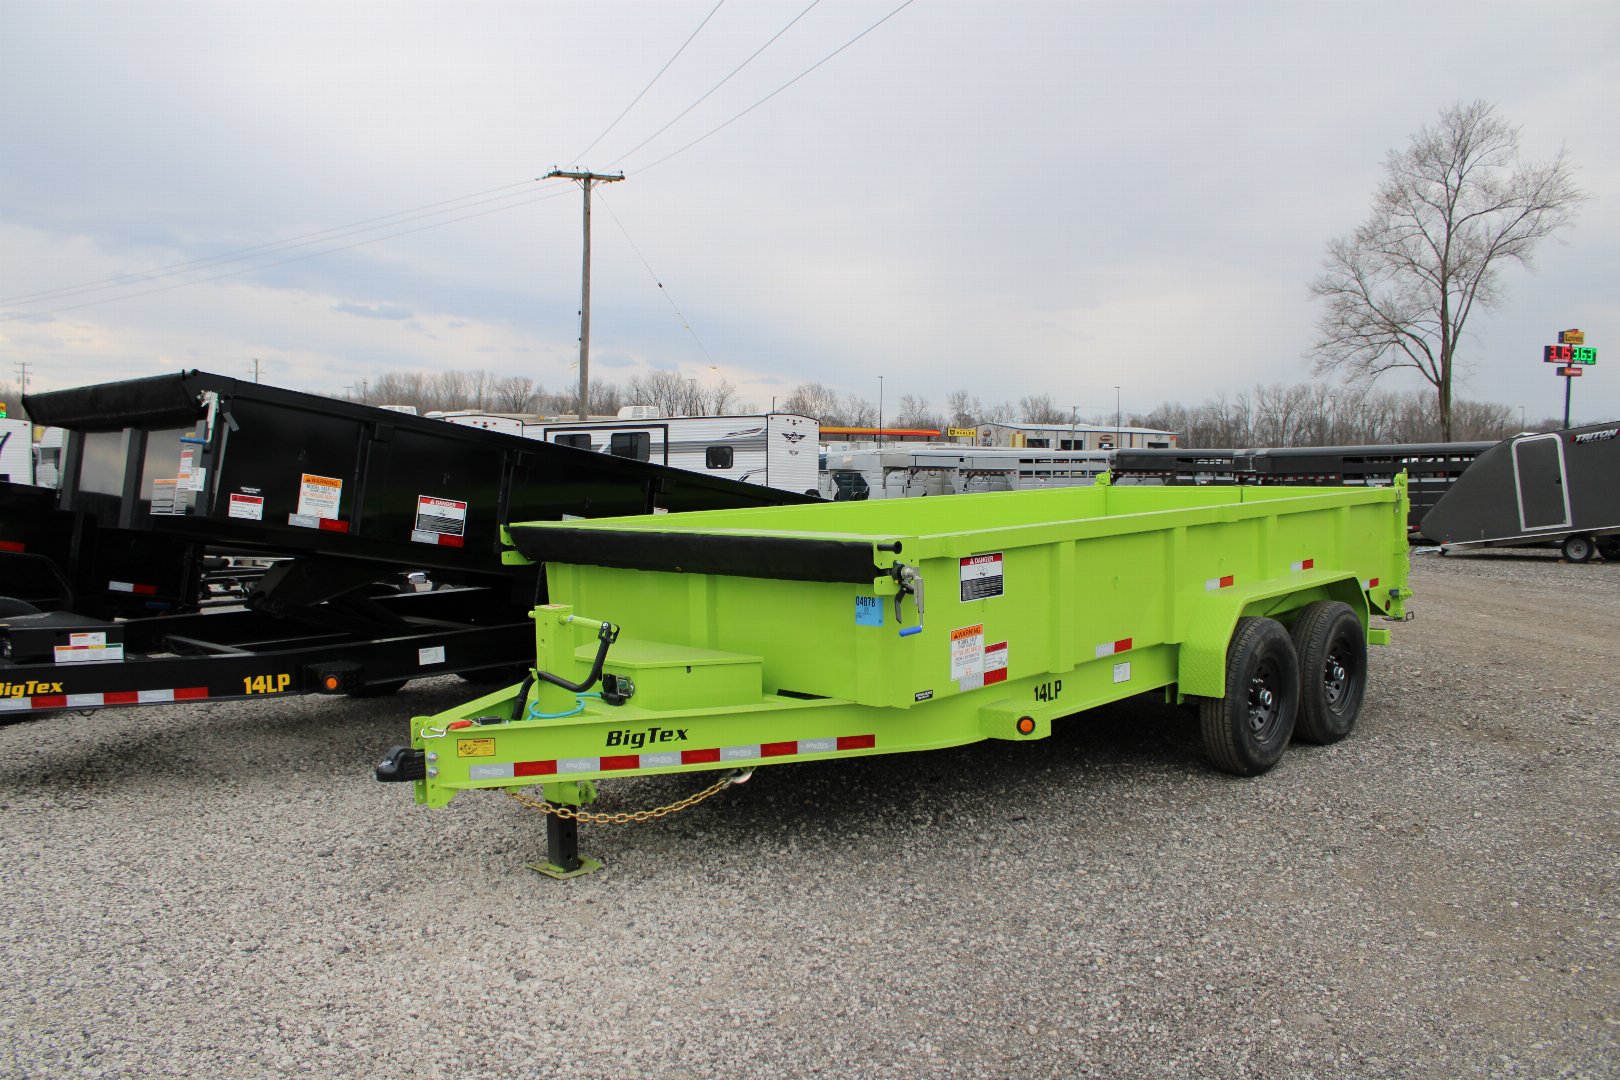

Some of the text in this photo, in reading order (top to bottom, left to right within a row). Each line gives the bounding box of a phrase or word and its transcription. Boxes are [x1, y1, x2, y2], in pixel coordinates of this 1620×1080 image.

[1576, 430, 1617, 442] TRITON
[311, 477, 338, 487] WARNING
[435, 500, 457, 508] DANGER
[974, 555, 994, 564] DANGER
[855, 596, 876, 607] 04878
[957, 627, 980, 638] WARNING
[243, 673, 291, 695] 14LP
[1034, 679, 1062, 703] 14LP
[605, 727, 689, 749] BigTex
